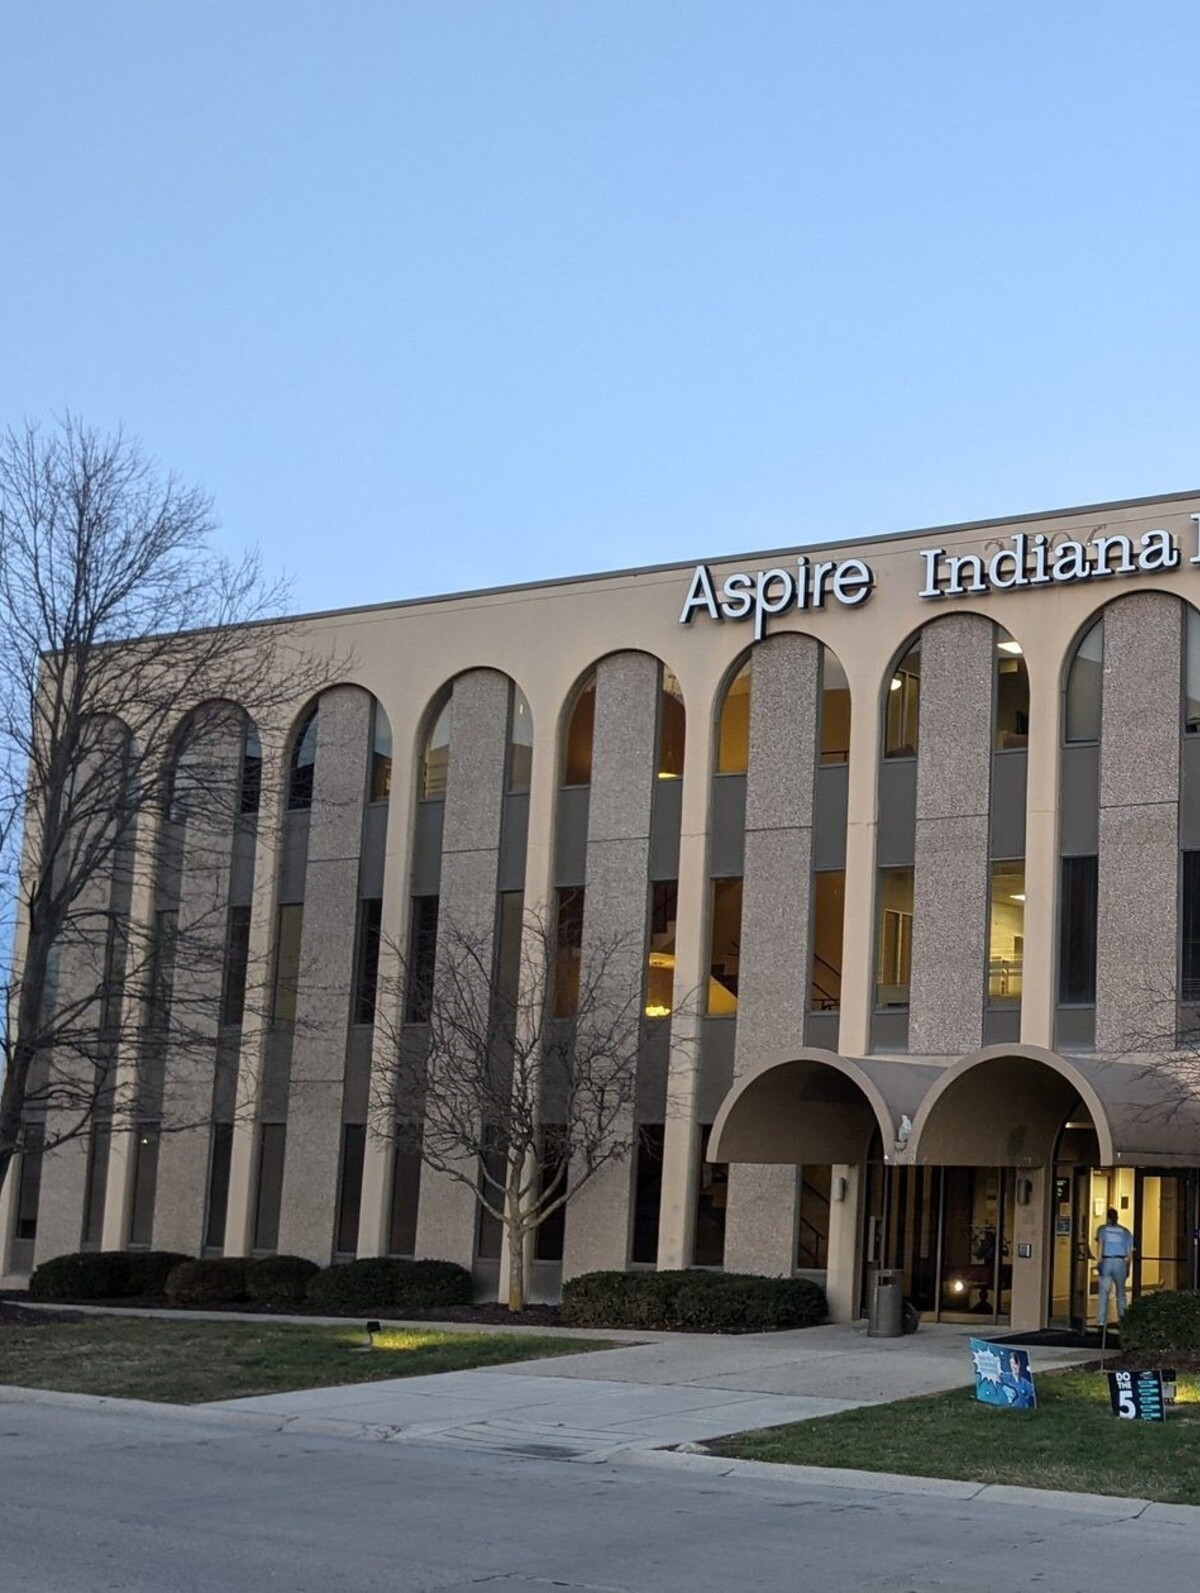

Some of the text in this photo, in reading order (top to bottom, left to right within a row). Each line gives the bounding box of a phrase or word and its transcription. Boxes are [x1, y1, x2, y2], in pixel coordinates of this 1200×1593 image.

[679, 556, 874, 640] Aspire
[918, 528, 1178, 597] Indiana
[1115, 1372, 1131, 1381] DO
[1117, 1381, 1132, 1389] THE
[1118, 1390, 1136, 1420] 5
